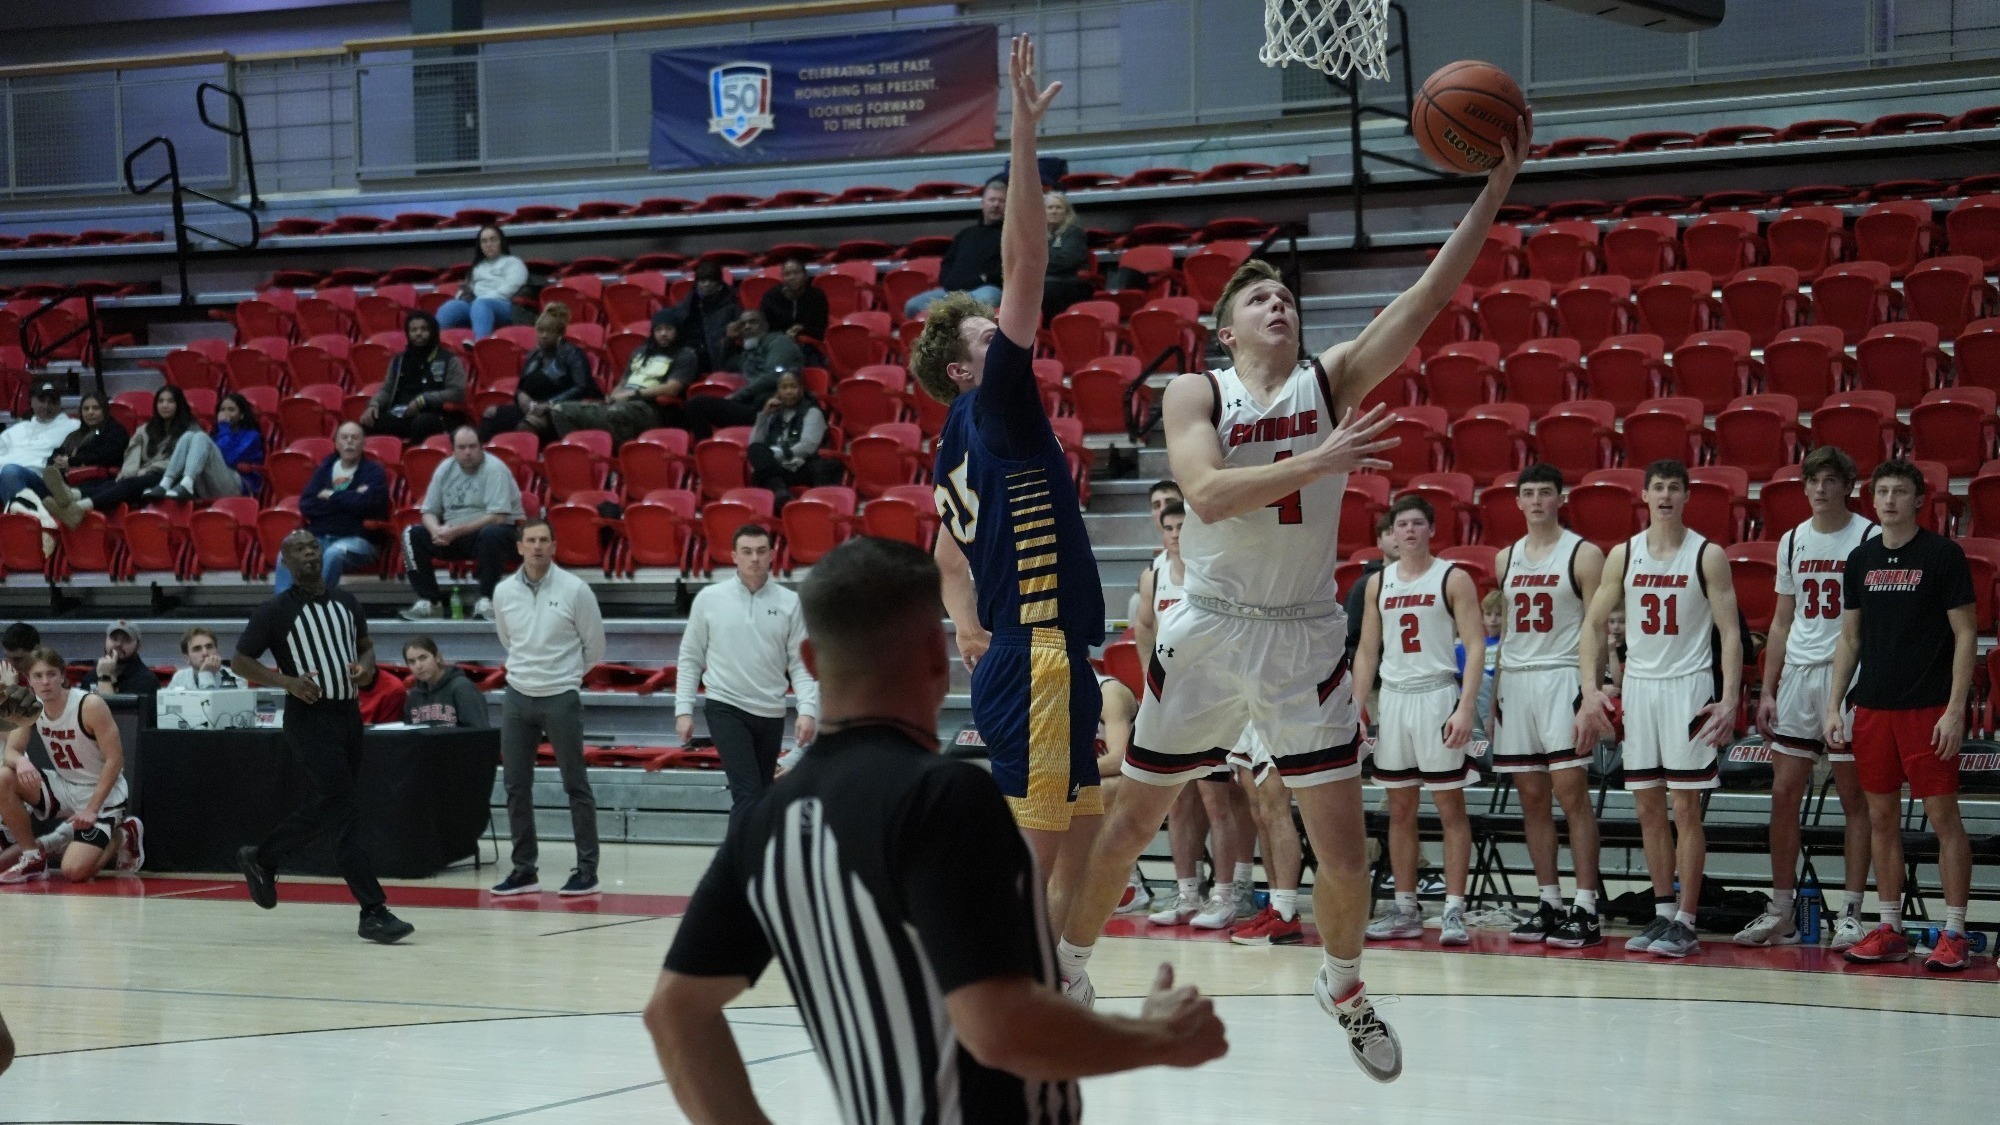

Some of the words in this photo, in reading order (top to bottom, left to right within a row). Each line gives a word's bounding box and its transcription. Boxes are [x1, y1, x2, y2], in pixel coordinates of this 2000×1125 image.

[798, 63, 876, 80] CELEBRATING
[878, 61, 900, 75] THE
[903, 59, 932, 72] PAST.
[724, 83, 758, 114] 50
[794, 84, 861, 100] HONORING
[863, 82, 884, 95] THE
[886, 78, 939, 93] PRESENT.
[808, 103, 863, 118] LOOKING
[867, 99, 926, 114] FORWARD
[823, 119, 839, 131] TO
[842, 117, 862, 130] THE
[1229, 409, 1318, 447] CATHOLIC
[1510, 574, 1560, 588] CATHOLIC
[1632, 573, 1689, 588] CATHOLIC
[1864, 569, 1923, 585] CATHOLIC
[1802, 578, 1841, 619] 33
[1868, 584, 1916, 592] BASKETBALL
[1384, 593, 1436, 610] CATHOLIC
[1514, 592, 1554, 633] 23
[1640, 593, 1679, 636] 31
[1399, 613, 1422, 654] 2
[50, 741, 84, 770] 21
